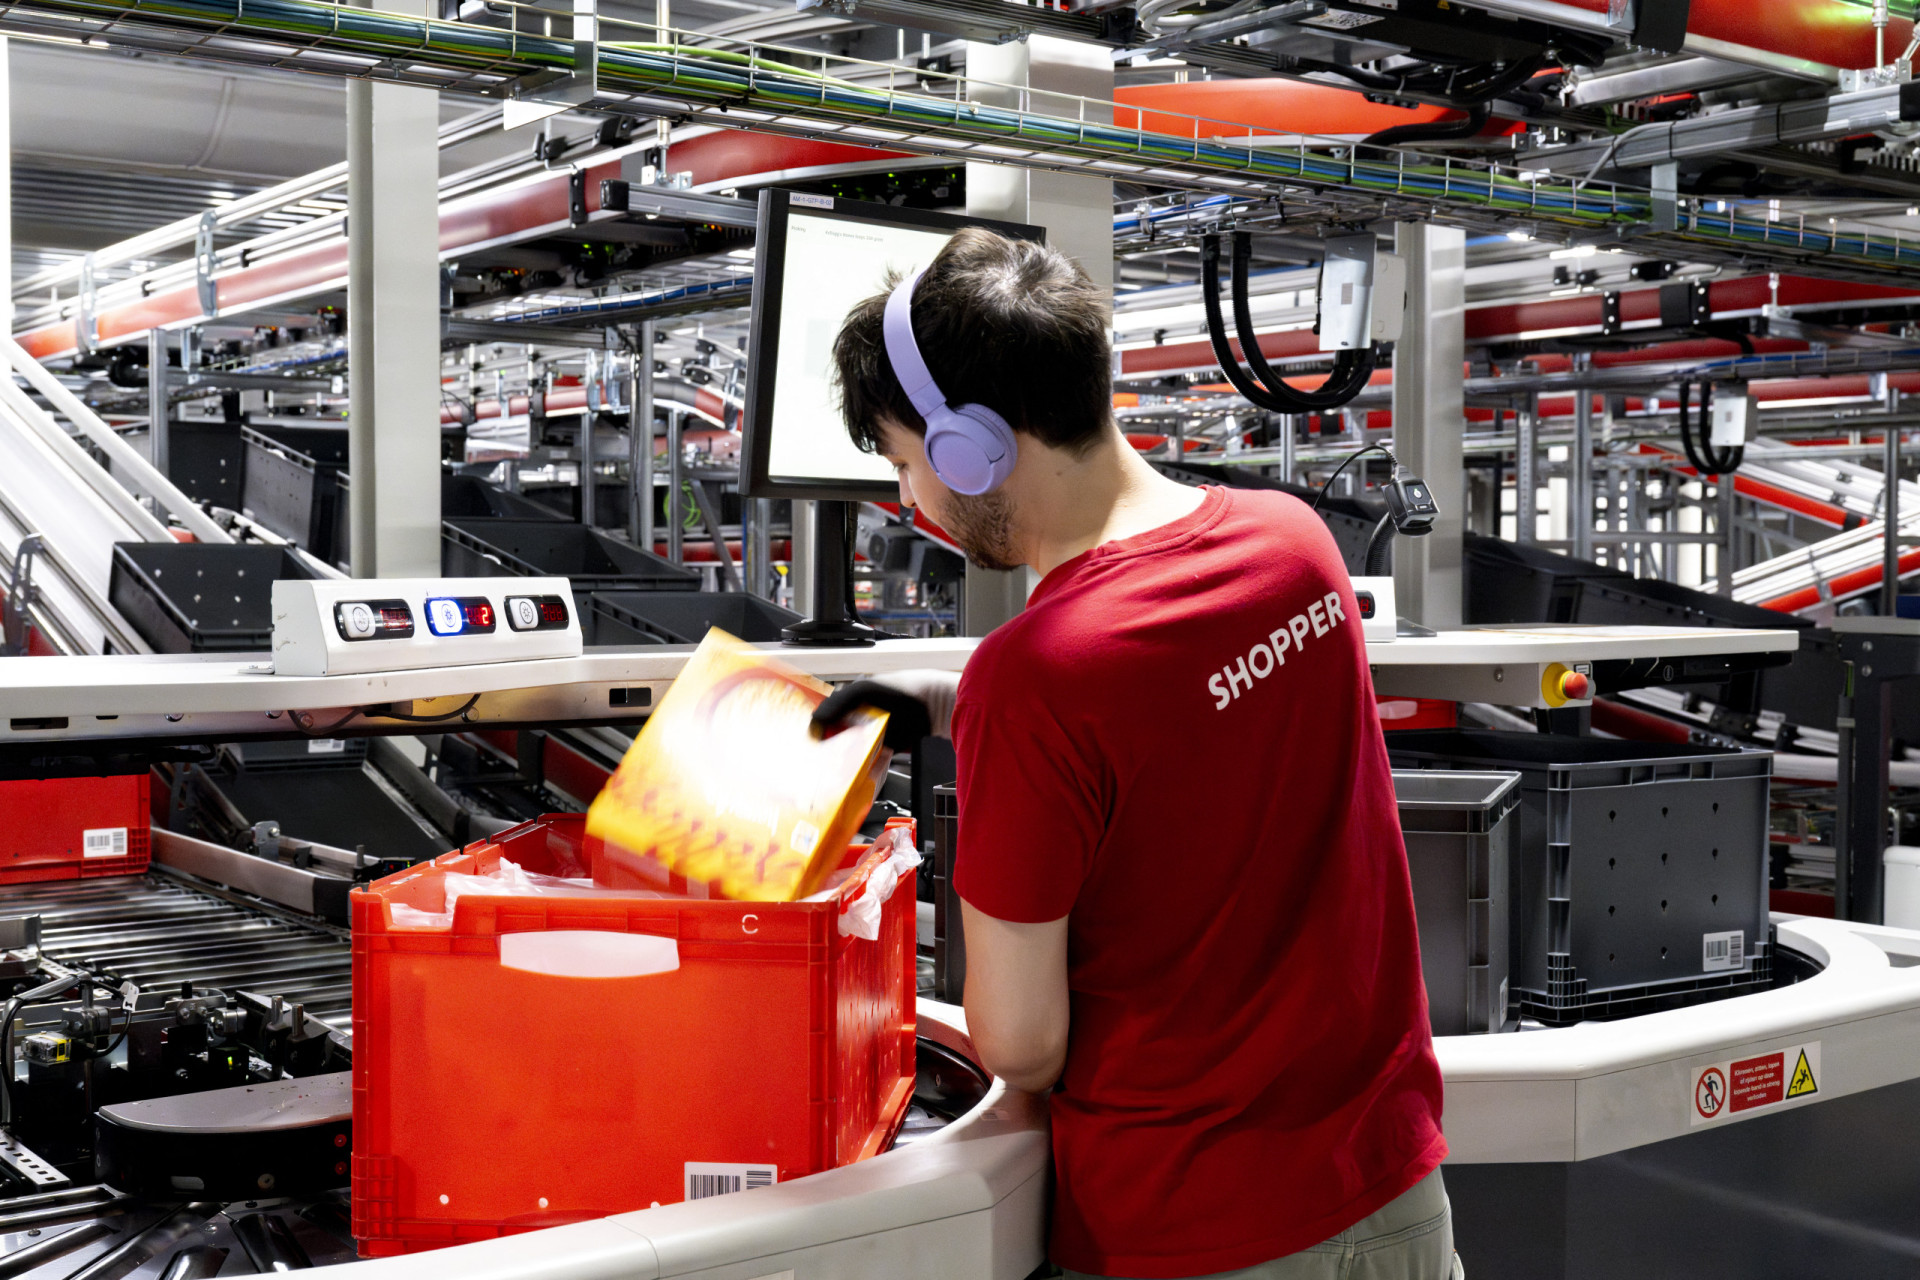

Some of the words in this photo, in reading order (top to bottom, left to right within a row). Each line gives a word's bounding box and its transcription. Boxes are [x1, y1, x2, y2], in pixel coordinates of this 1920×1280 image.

[1208, 591, 1346, 711] SHOPPER
[742, 914, 758, 934] C
[1747, 1092, 1767, 1101] verboden
